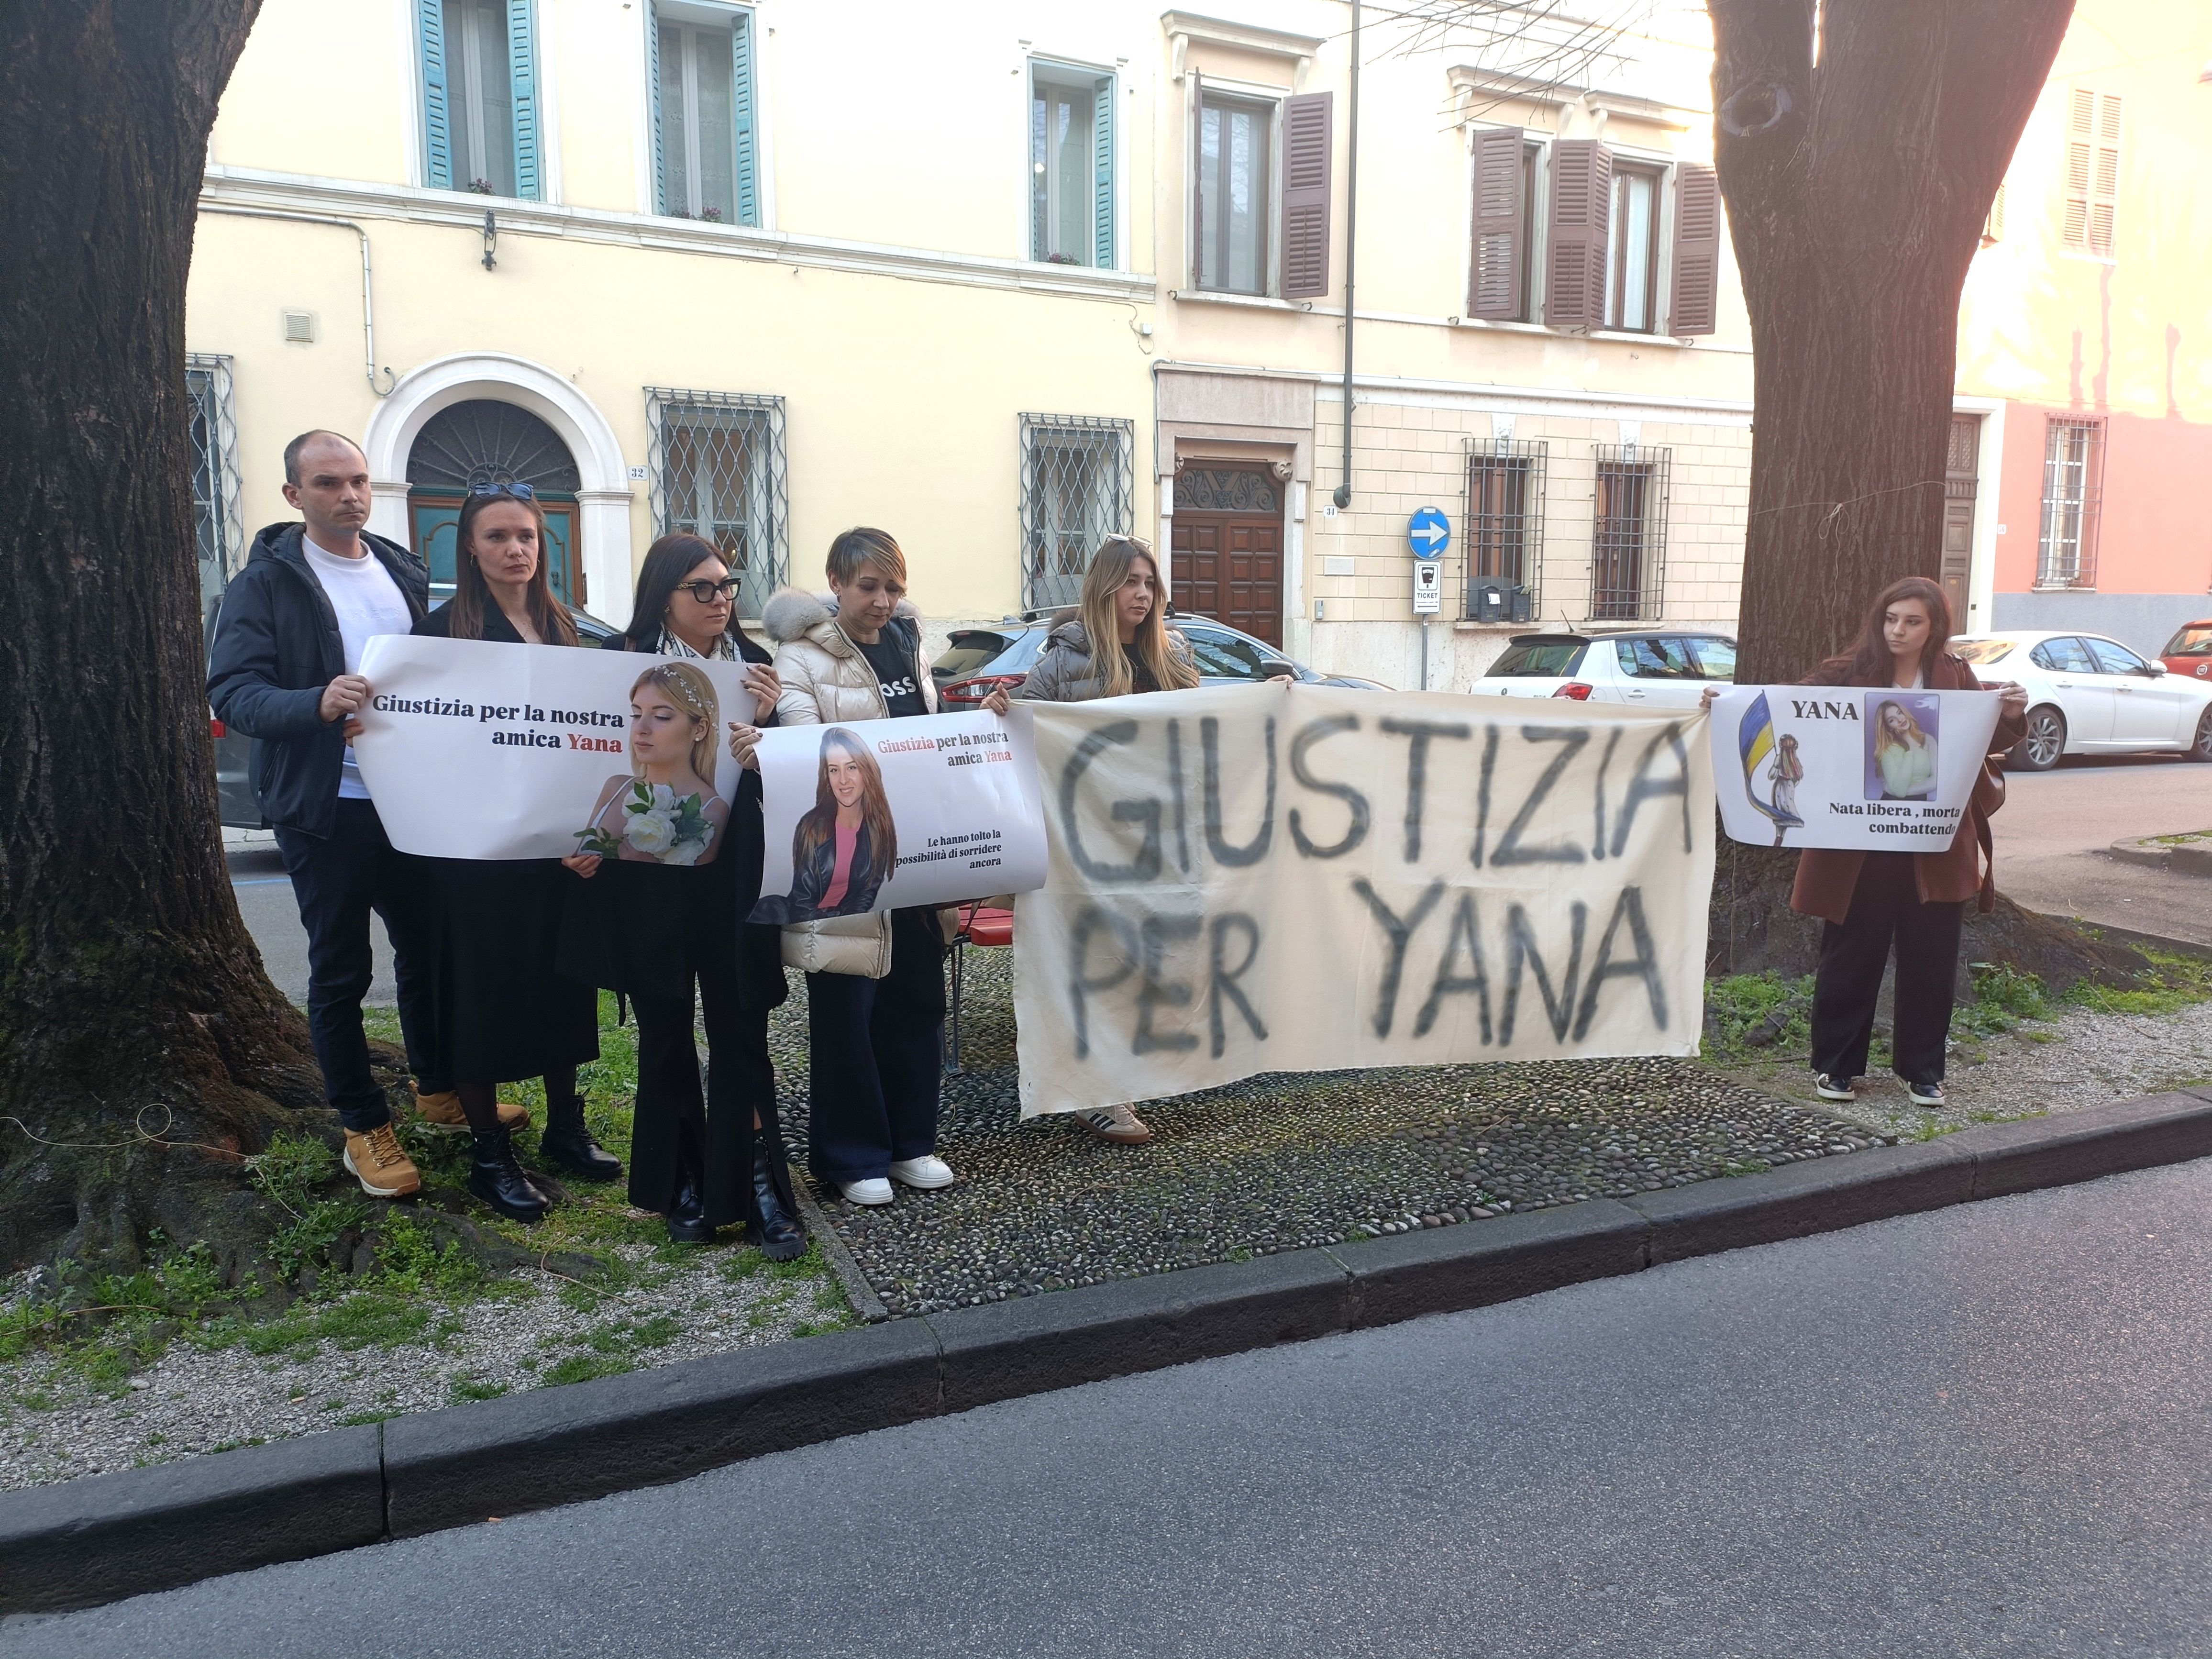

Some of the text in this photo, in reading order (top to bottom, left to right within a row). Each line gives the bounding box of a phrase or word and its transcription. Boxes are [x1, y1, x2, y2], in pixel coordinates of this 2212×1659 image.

[631, 467, 643, 478] 32
[1327, 507, 1335, 516] 34
[880, 676, 916, 697] OSS
[372, 695, 625, 728] Giustizia per la nostra
[1791, 700, 1859, 720] YANA
[492, 729, 623, 753] amica Yana
[877, 731, 1009, 753] Giustizia per la nostra
[948, 751, 1013, 767] amica Yana
[1059, 713, 1692, 882] GIUSTIZIA
[1829, 803, 1864, 815] Nata
[1866, 803, 1912, 817] libera
[1922, 807, 1960, 818] morta
[928, 829, 1002, 848] Le hanno tolto la
[1869, 822, 1956, 835] combattendo
[895, 844, 1002, 868] possibilità di sorridere
[969, 857, 1002, 869] ancora
[1070, 877, 1669, 1060] PER YANA
